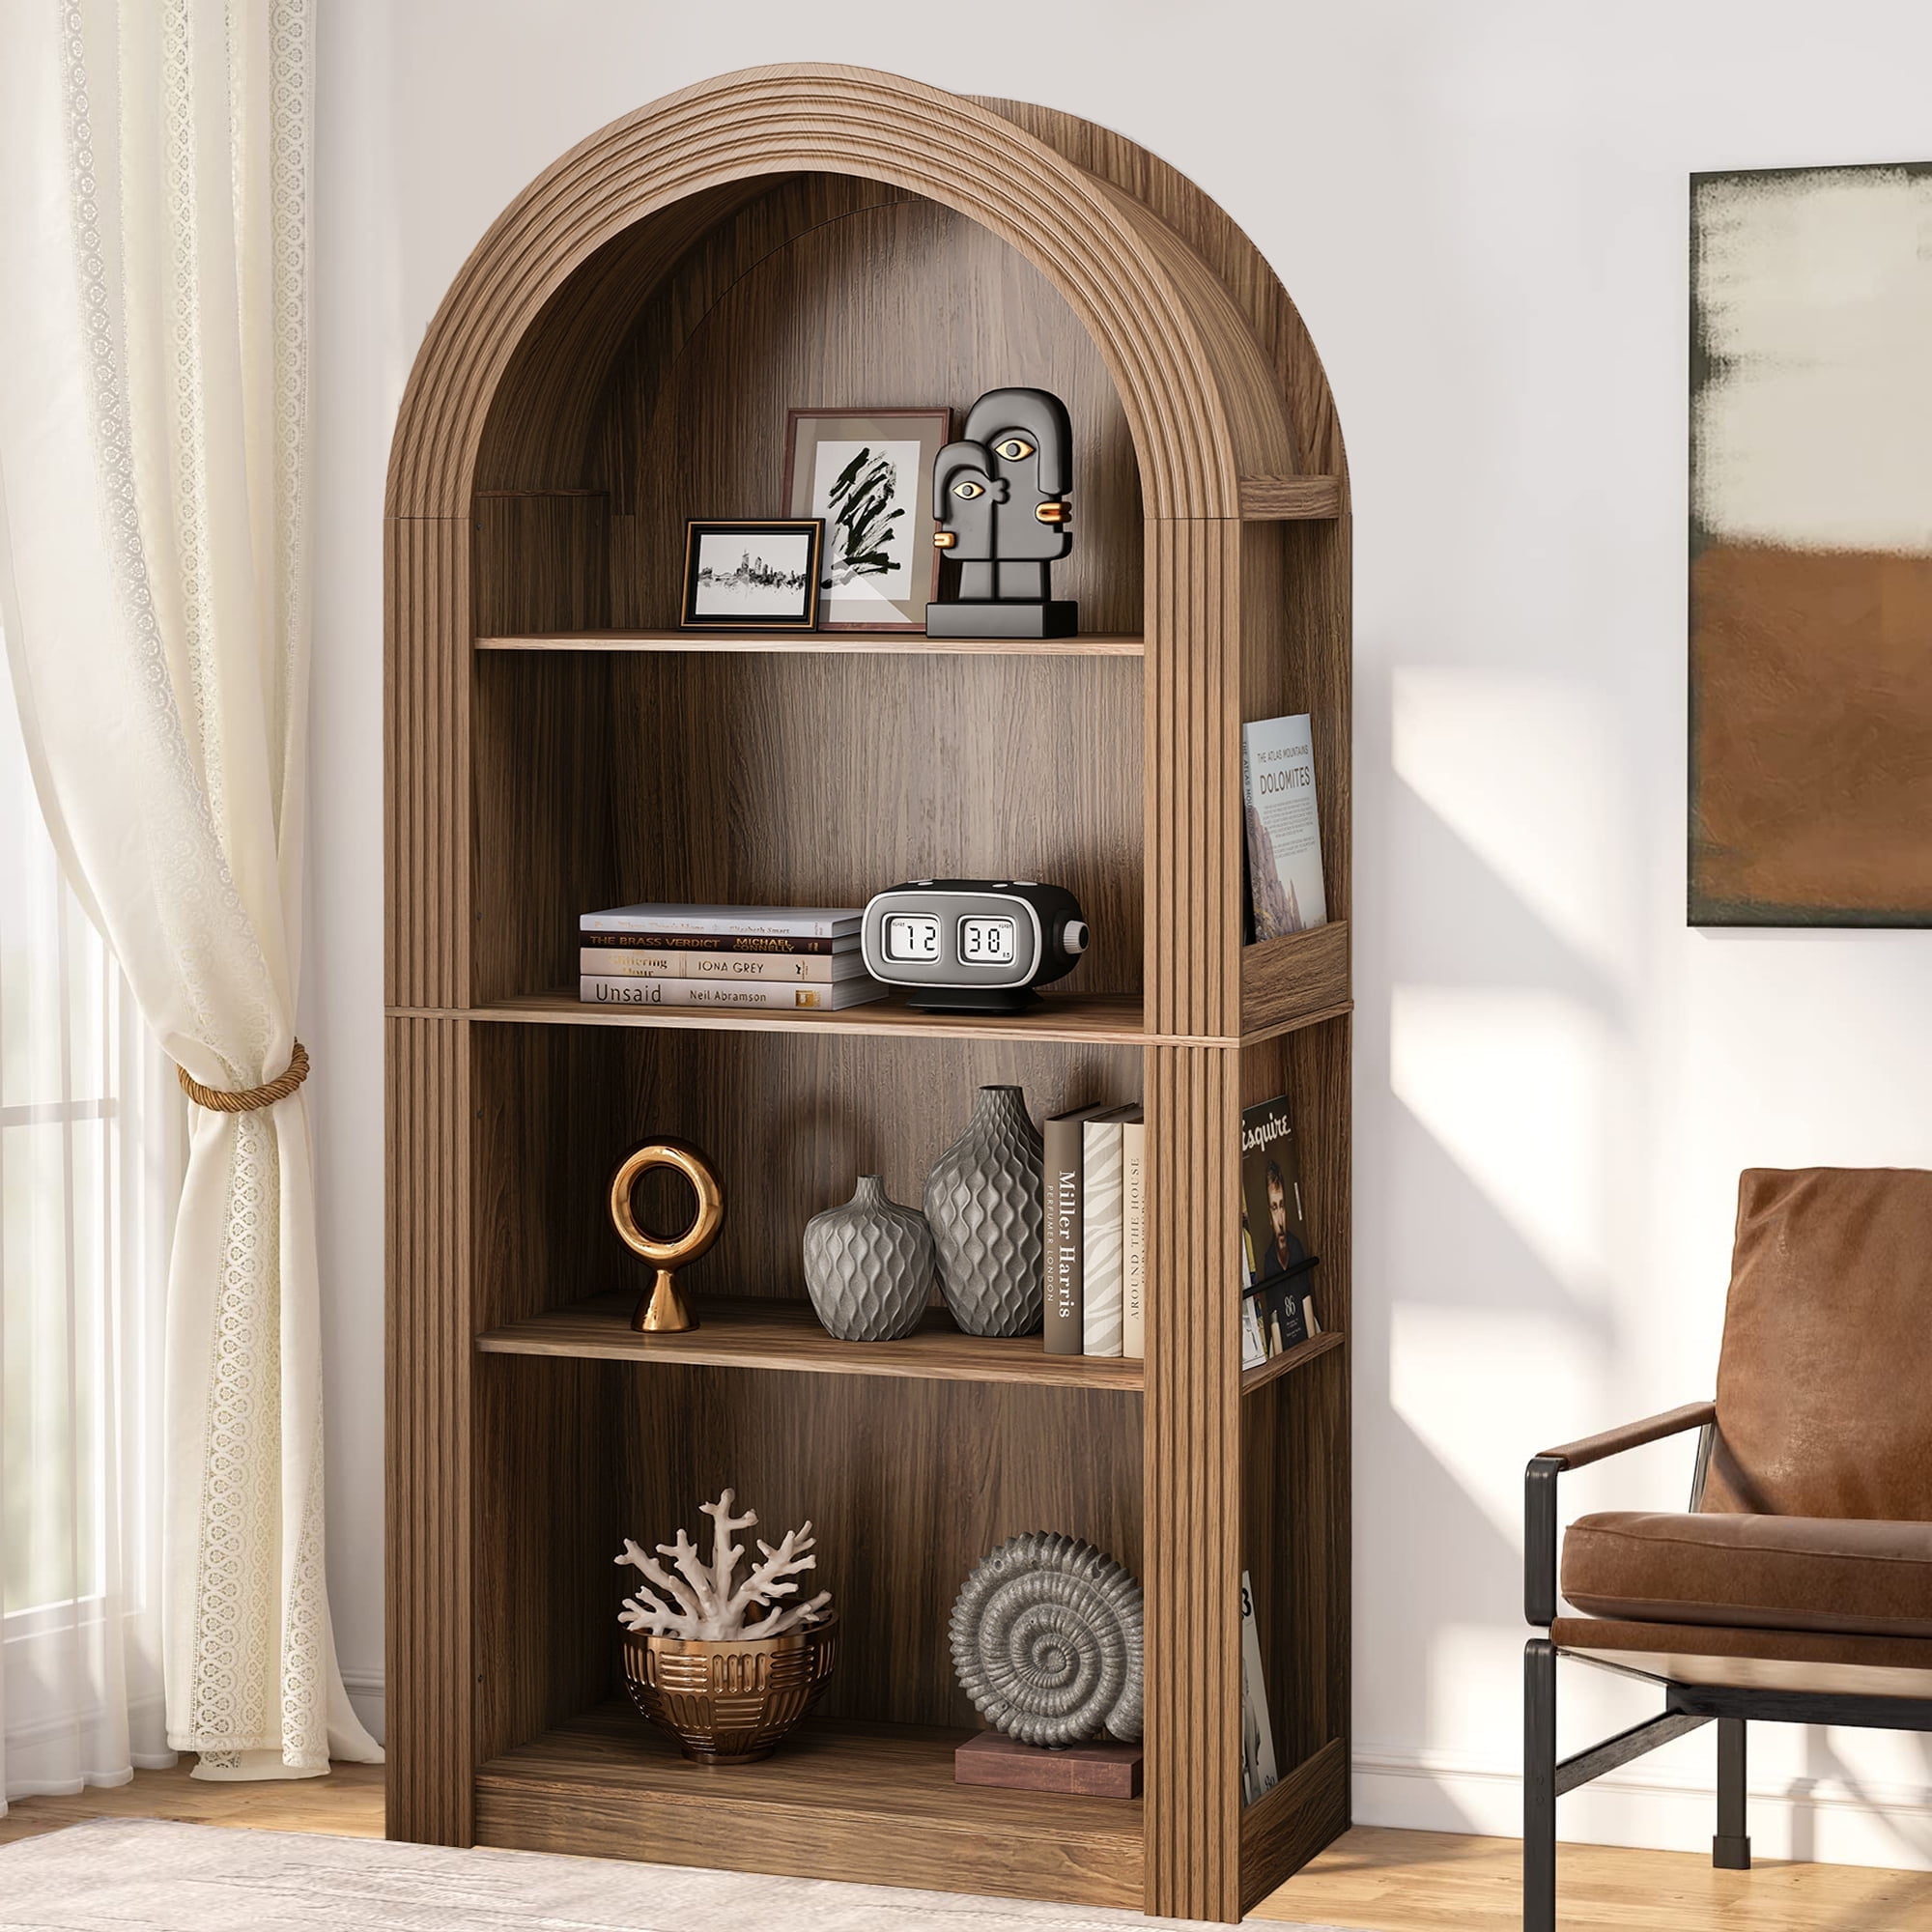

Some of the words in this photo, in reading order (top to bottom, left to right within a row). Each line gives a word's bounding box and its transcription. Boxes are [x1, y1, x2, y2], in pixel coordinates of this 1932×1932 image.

[1260, 765, 1311, 795] DOLOMITES
[589, 935, 616, 945] THE
[619, 936, 662, 947] BRASS
[665, 938, 721, 948] VERDICT
[732, 944, 794, 952] CONNELLY
[736, 938, 791, 947] MICHAEL
[907, 925, 936, 952] 12
[969, 927, 1000, 953] 30
[697, 961, 728, 972] IONA
[732, 962, 764, 974] GREY
[595, 983, 662, 1003] Unsaid
[689, 990, 710, 1001] Neil
[714, 990, 767, 1003] Abramson
[1130, 1158, 1140, 1210] HOUSE
[1059, 1171, 1076, 1239] Miller
[1130, 1216, 1140, 1248] THE
[1059, 1246, 1076, 1319] Harris
[1130, 1254, 1140, 1320] AROUND
